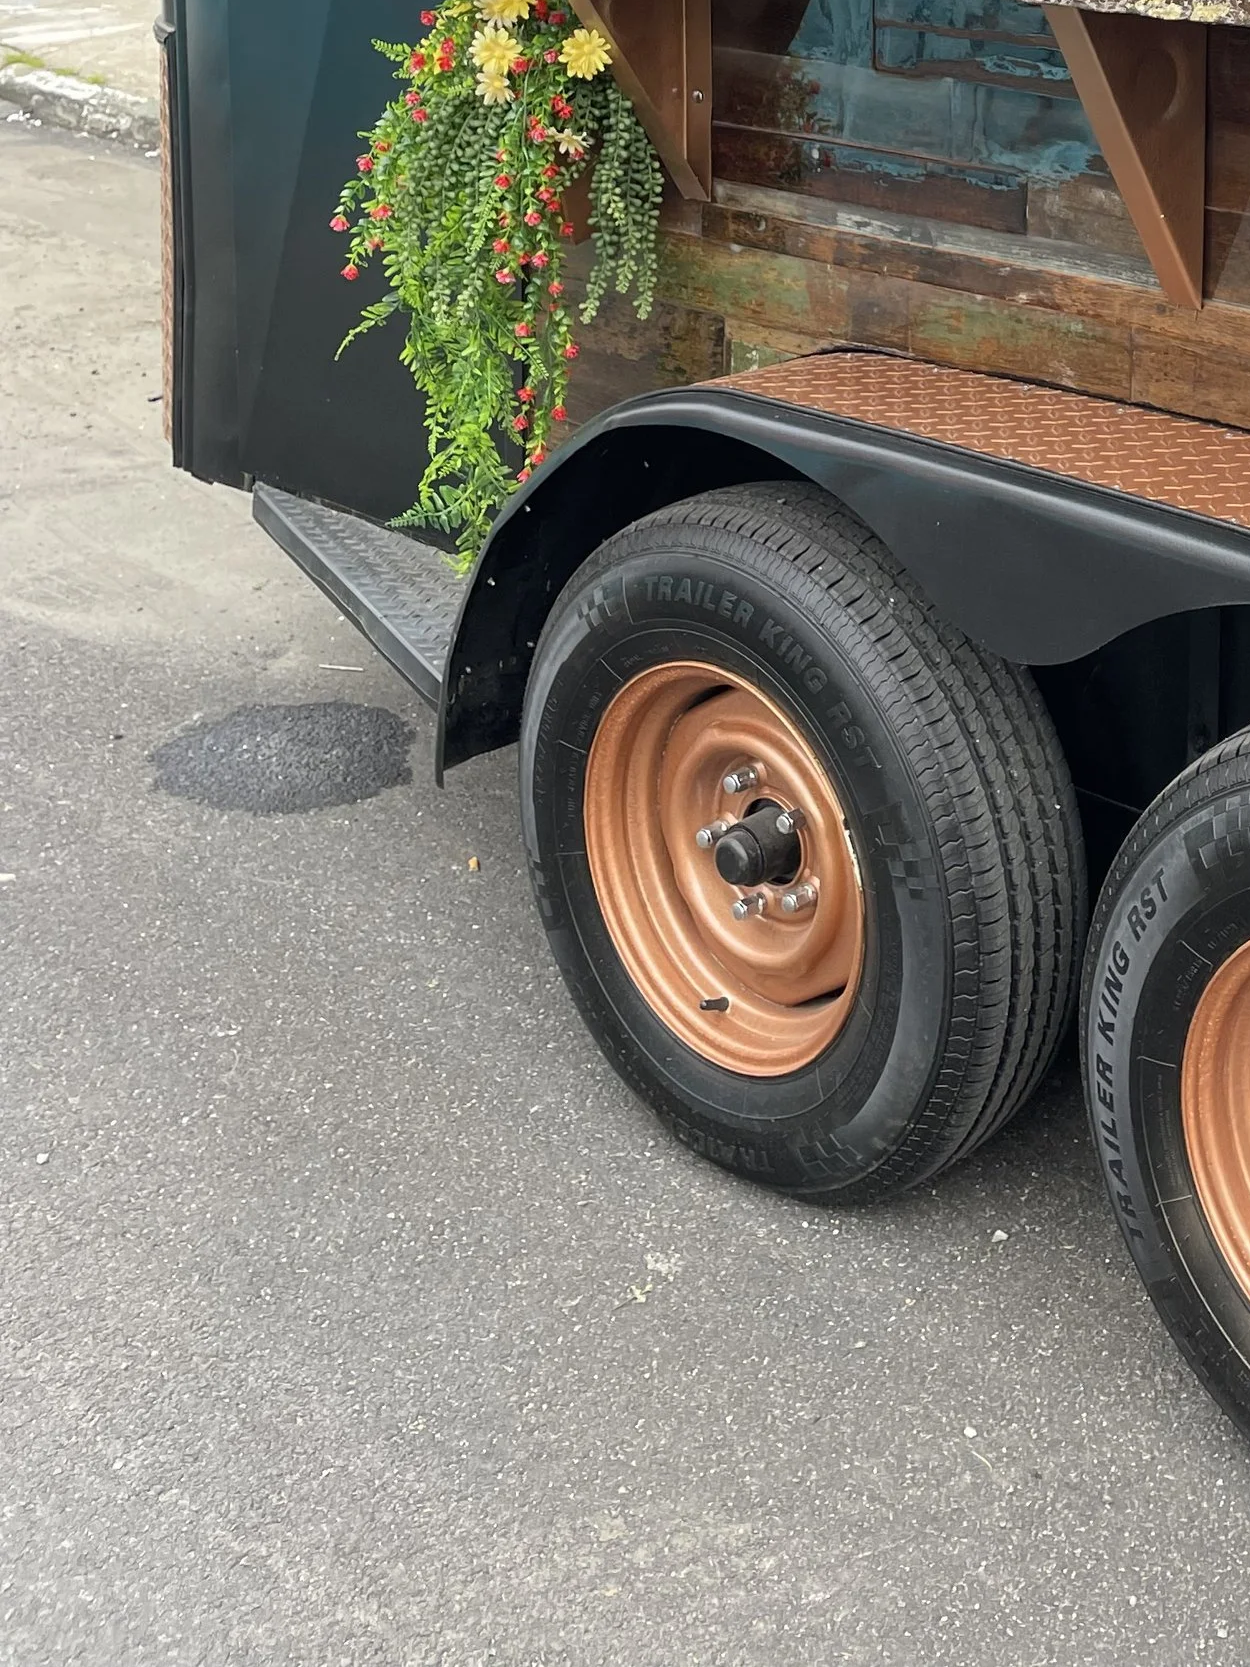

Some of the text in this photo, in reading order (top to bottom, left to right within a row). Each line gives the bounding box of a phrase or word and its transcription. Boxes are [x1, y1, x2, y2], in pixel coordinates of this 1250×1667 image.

[645, 574, 883, 769] TRAILER KING RST
[1095, 868, 1171, 1239] TRAILER KING RST
